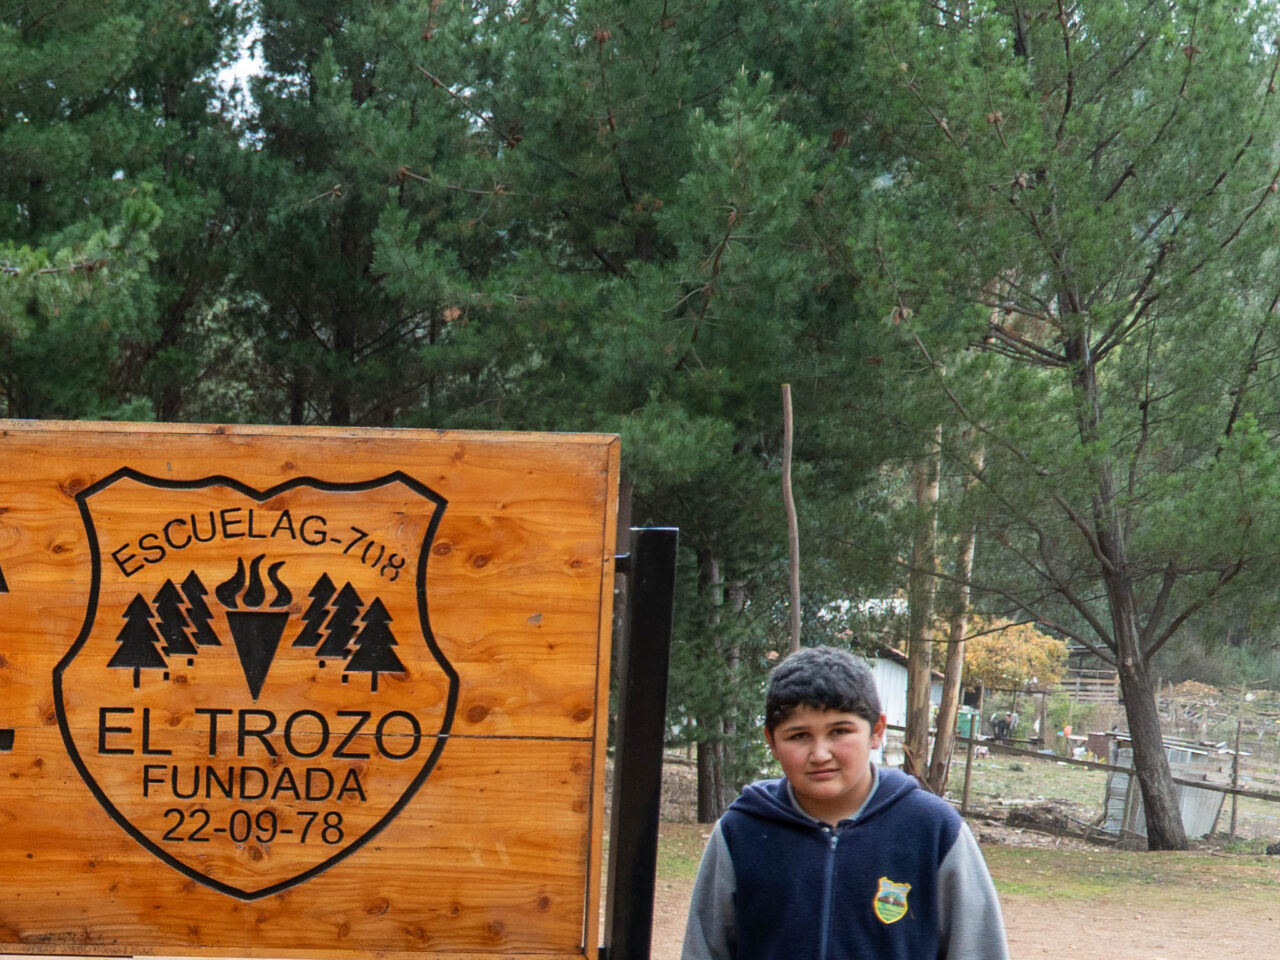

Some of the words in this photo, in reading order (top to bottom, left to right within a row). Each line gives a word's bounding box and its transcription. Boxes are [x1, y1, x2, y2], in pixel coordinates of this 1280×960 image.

[96, 706, 174, 757] EL
[193, 707, 424, 761] TROZO
[142, 763, 368, 803] FUNDADA
[161, 807, 345, 846] 22-09-78
